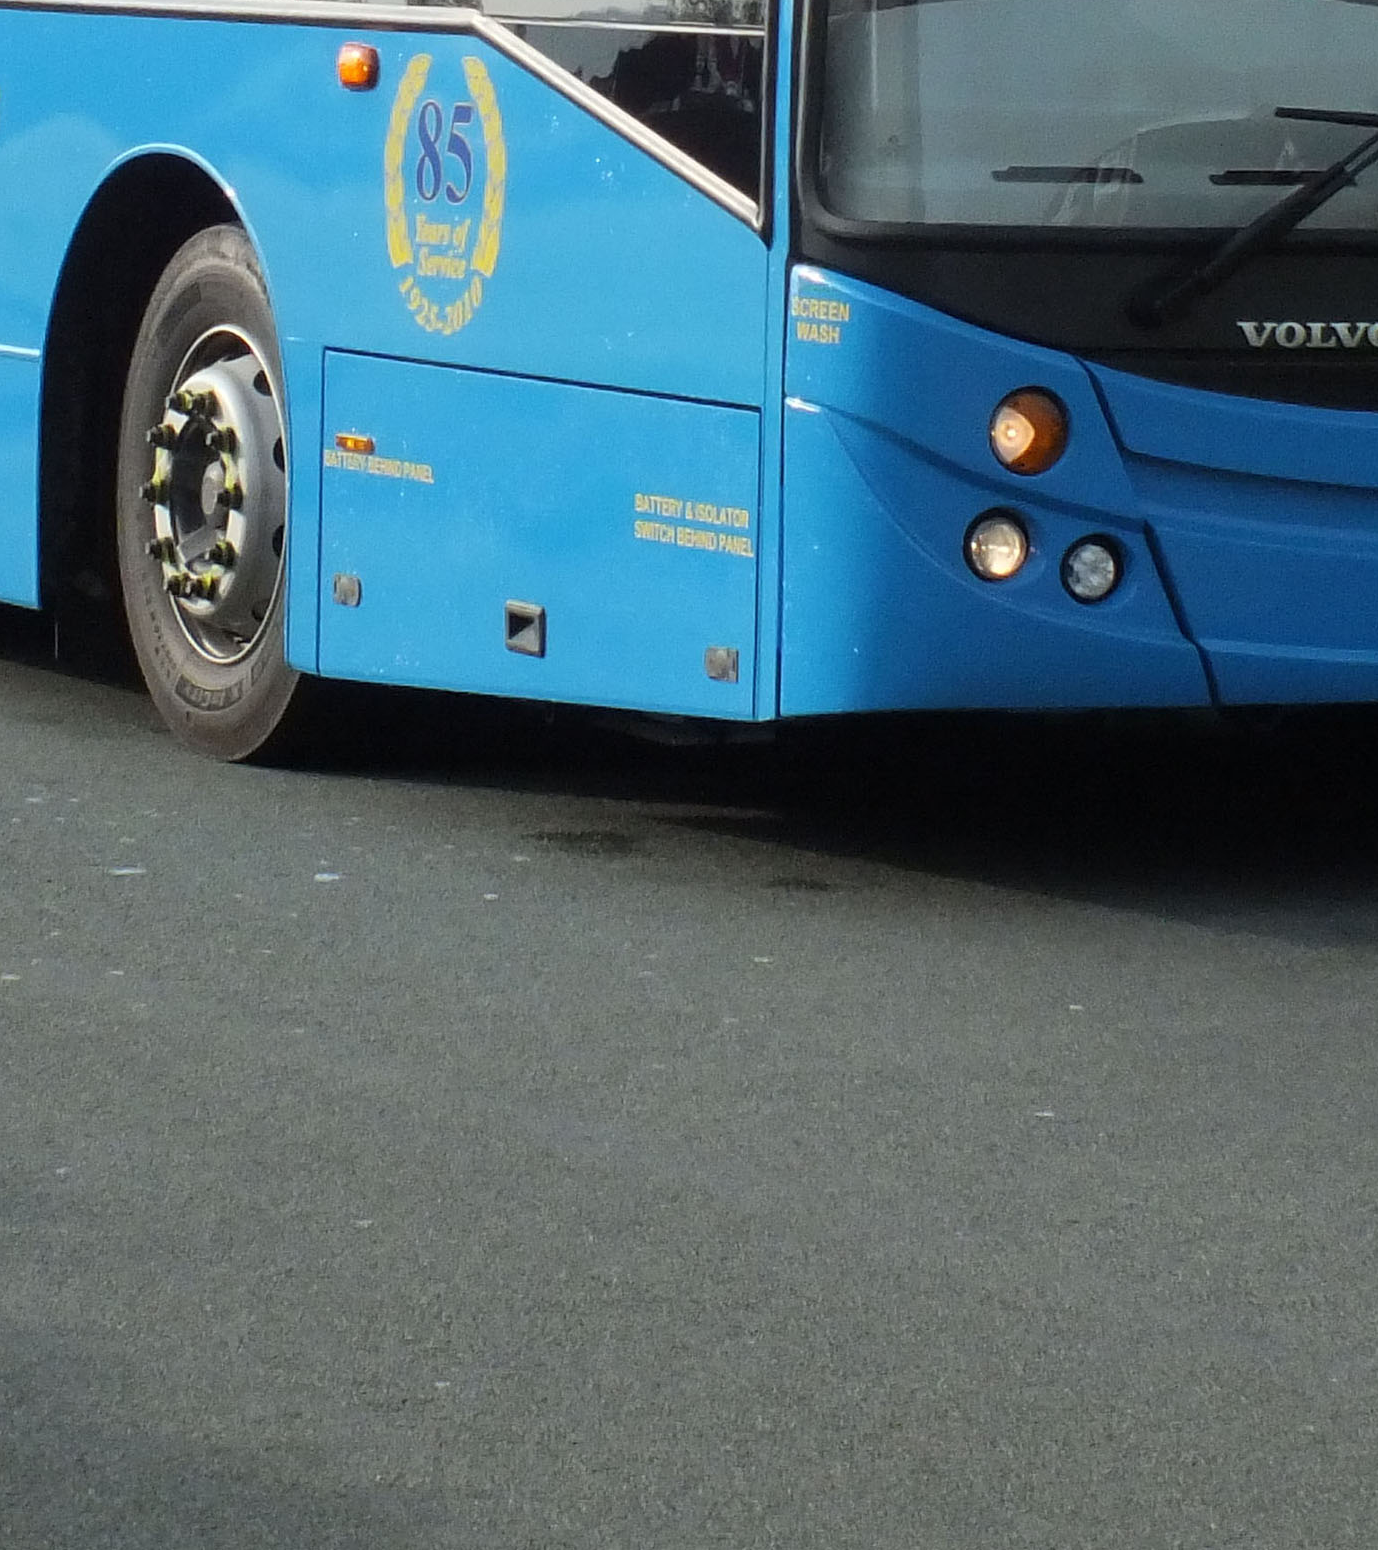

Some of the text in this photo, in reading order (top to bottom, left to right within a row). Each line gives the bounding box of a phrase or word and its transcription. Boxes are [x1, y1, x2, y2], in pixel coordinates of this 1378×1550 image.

[415, 98, 474, 205] 85
[791, 296, 850, 322] SCREEN
[796, 320, 840, 344] WASH
[324, 449, 434, 484] BATTERY BEHIND PANEL
[634, 493, 682, 518] BATTERY
[695, 503, 749, 529] ISOLATOR
[634, 520, 754, 558] SWITCH BEHIND PANEL
